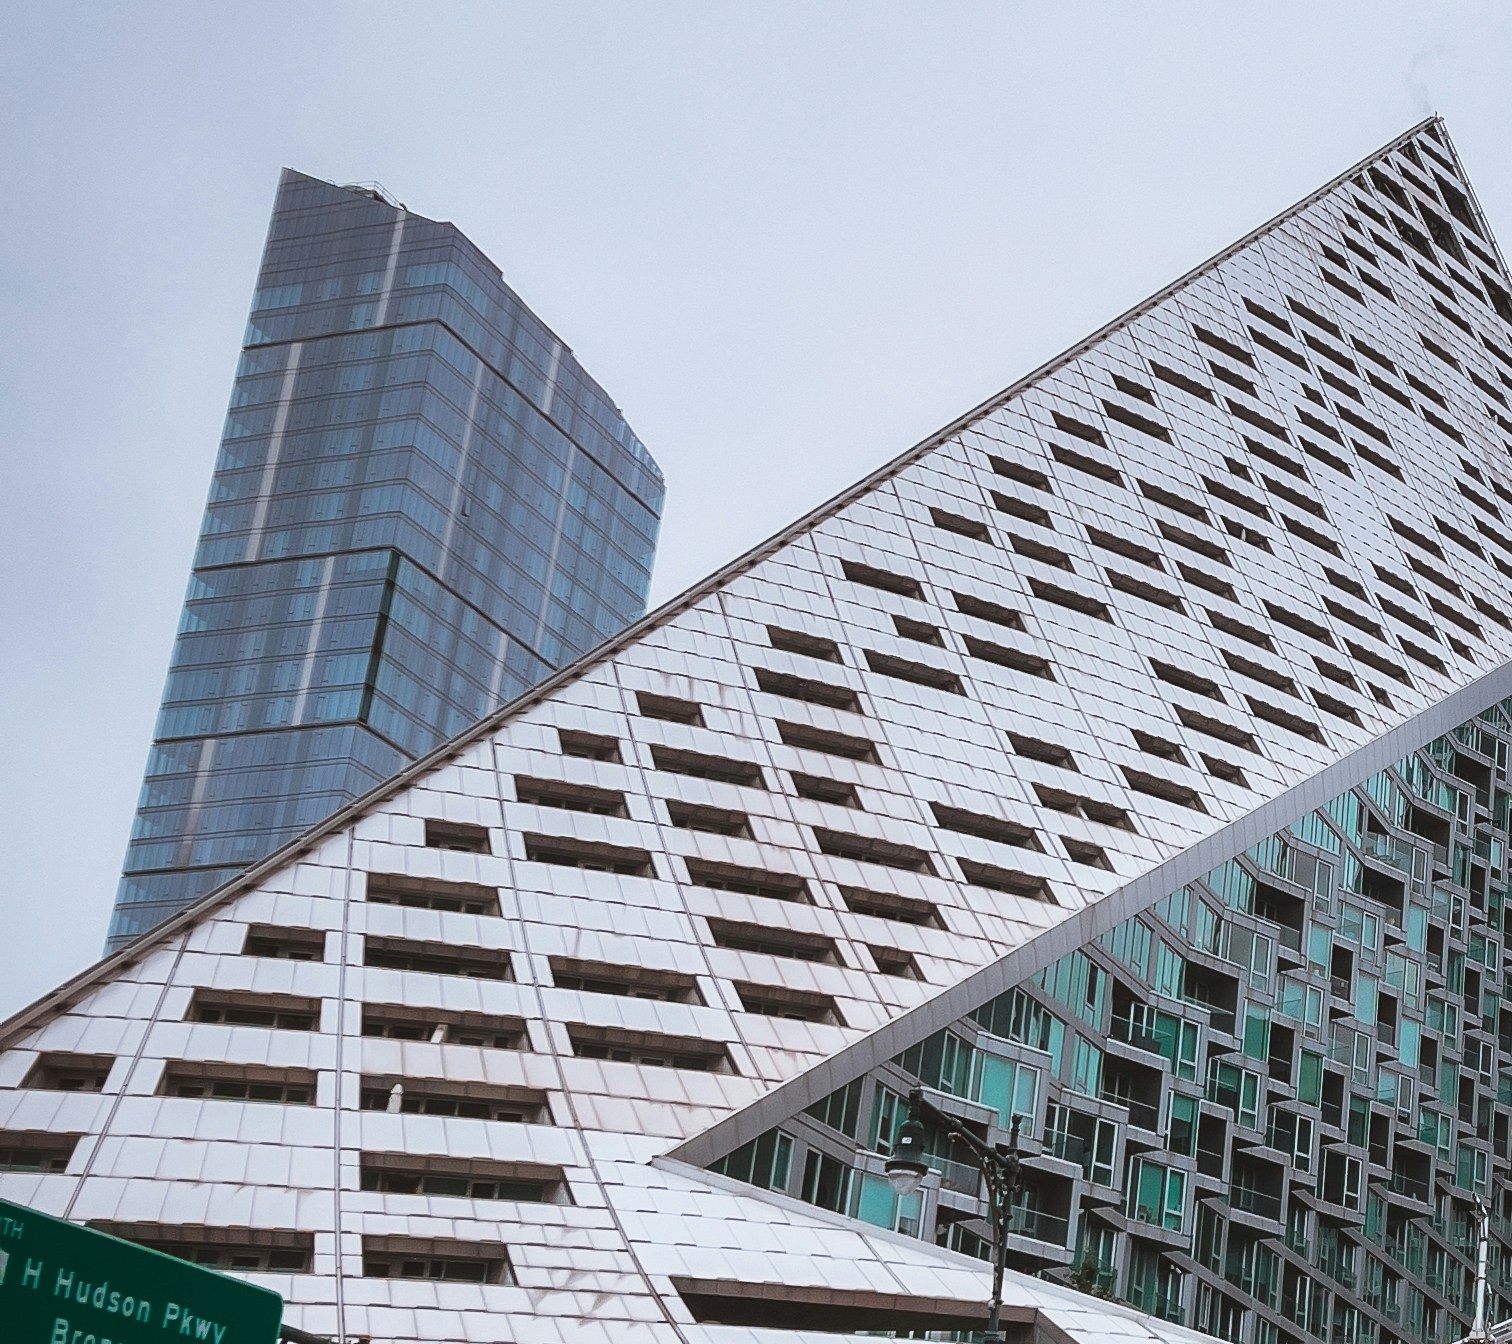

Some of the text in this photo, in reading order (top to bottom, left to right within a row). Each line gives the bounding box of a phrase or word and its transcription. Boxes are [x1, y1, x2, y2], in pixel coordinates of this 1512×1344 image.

[0, 1217, 24, 1240] TH
[21, 1258, 44, 1290] H
[53, 1268, 151, 1323] Hudson
